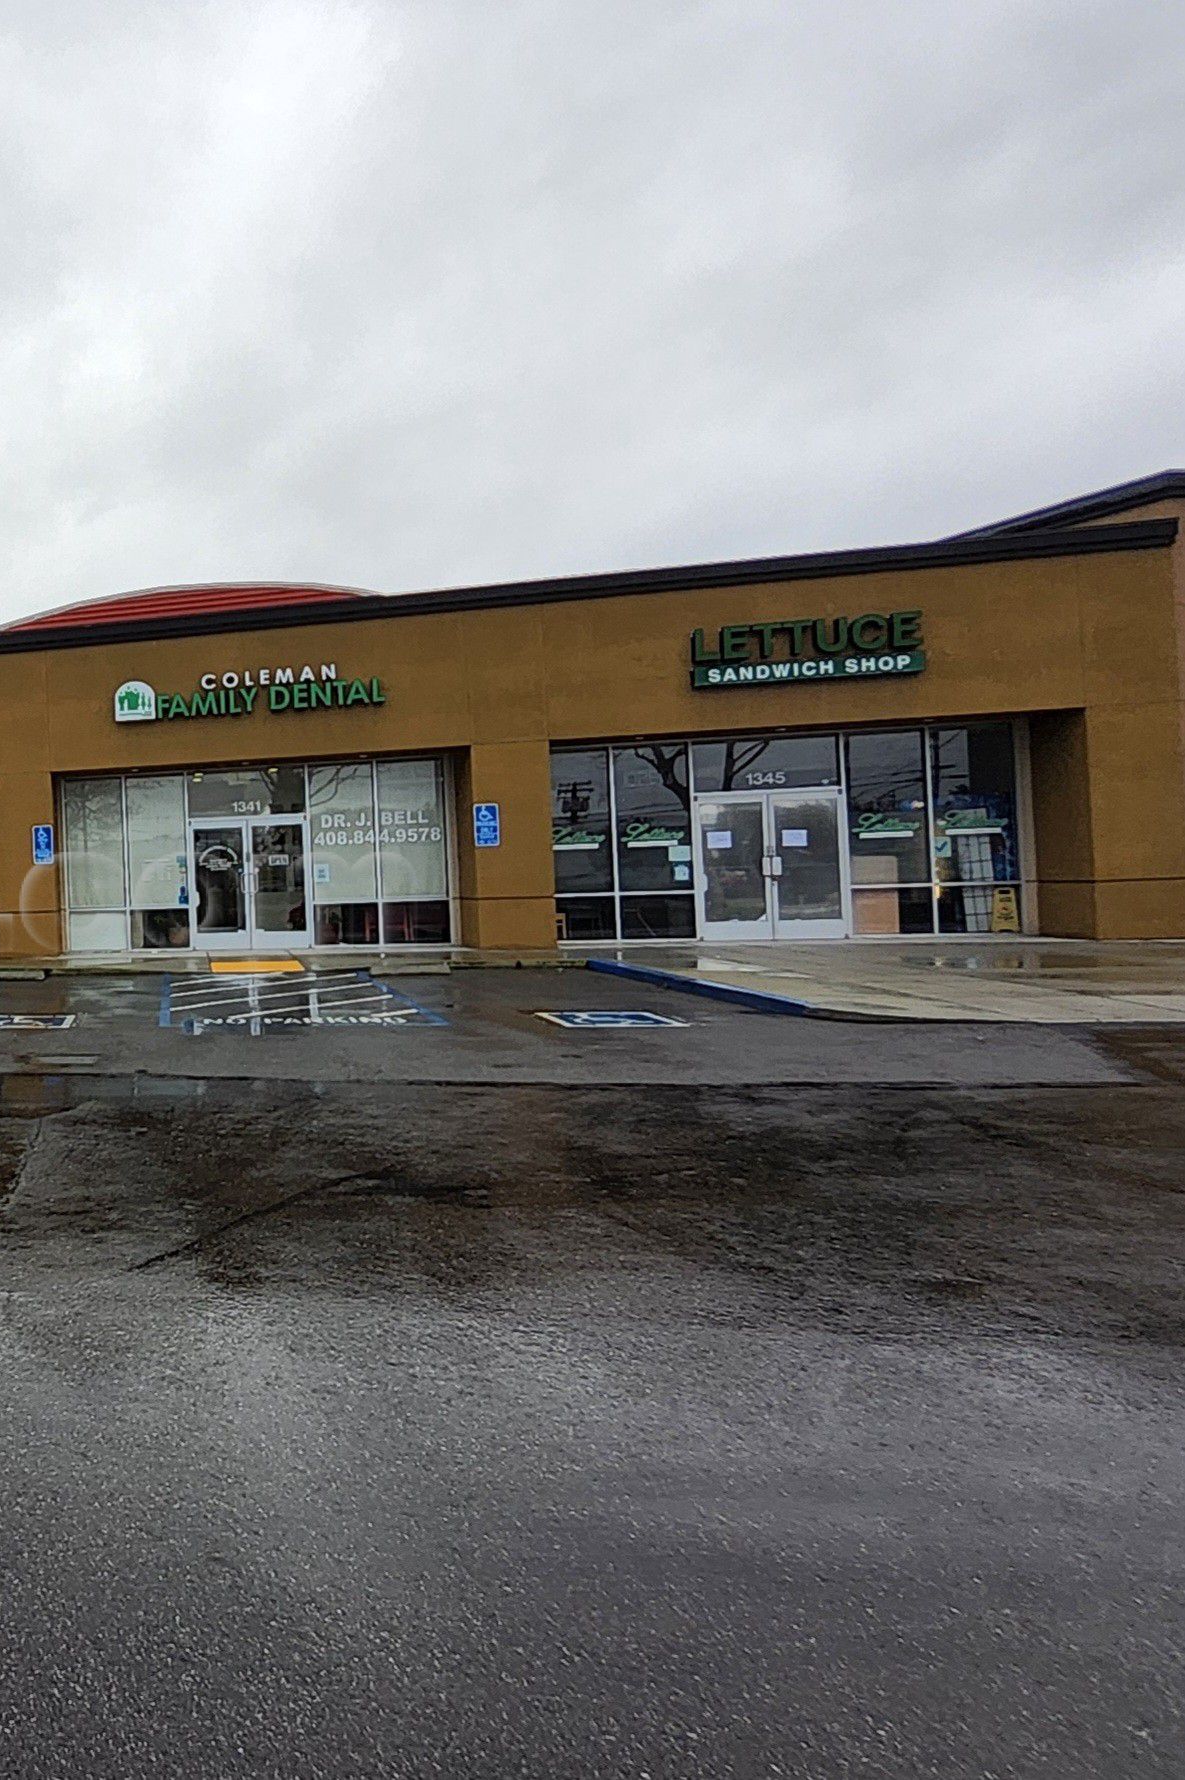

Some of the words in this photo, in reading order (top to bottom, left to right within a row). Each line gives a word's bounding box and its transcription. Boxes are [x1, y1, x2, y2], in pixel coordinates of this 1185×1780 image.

[691, 610, 923, 663] LETTUCE
[201, 663, 337, 690] COLEMAN
[708, 660, 834, 683] SANDWICH
[845, 654, 912, 674] SHOP
[157, 686, 257, 719] FAMILY
[269, 677, 387, 710] DENTAL
[745, 771, 786, 785] 1345
[232, 801, 262, 812] 1341
[320, 813, 351, 829] DR.
[355, 812, 372, 827] J.
[380, 810, 429, 826] BELL
[314, 827, 441, 846] 408.844.9578
